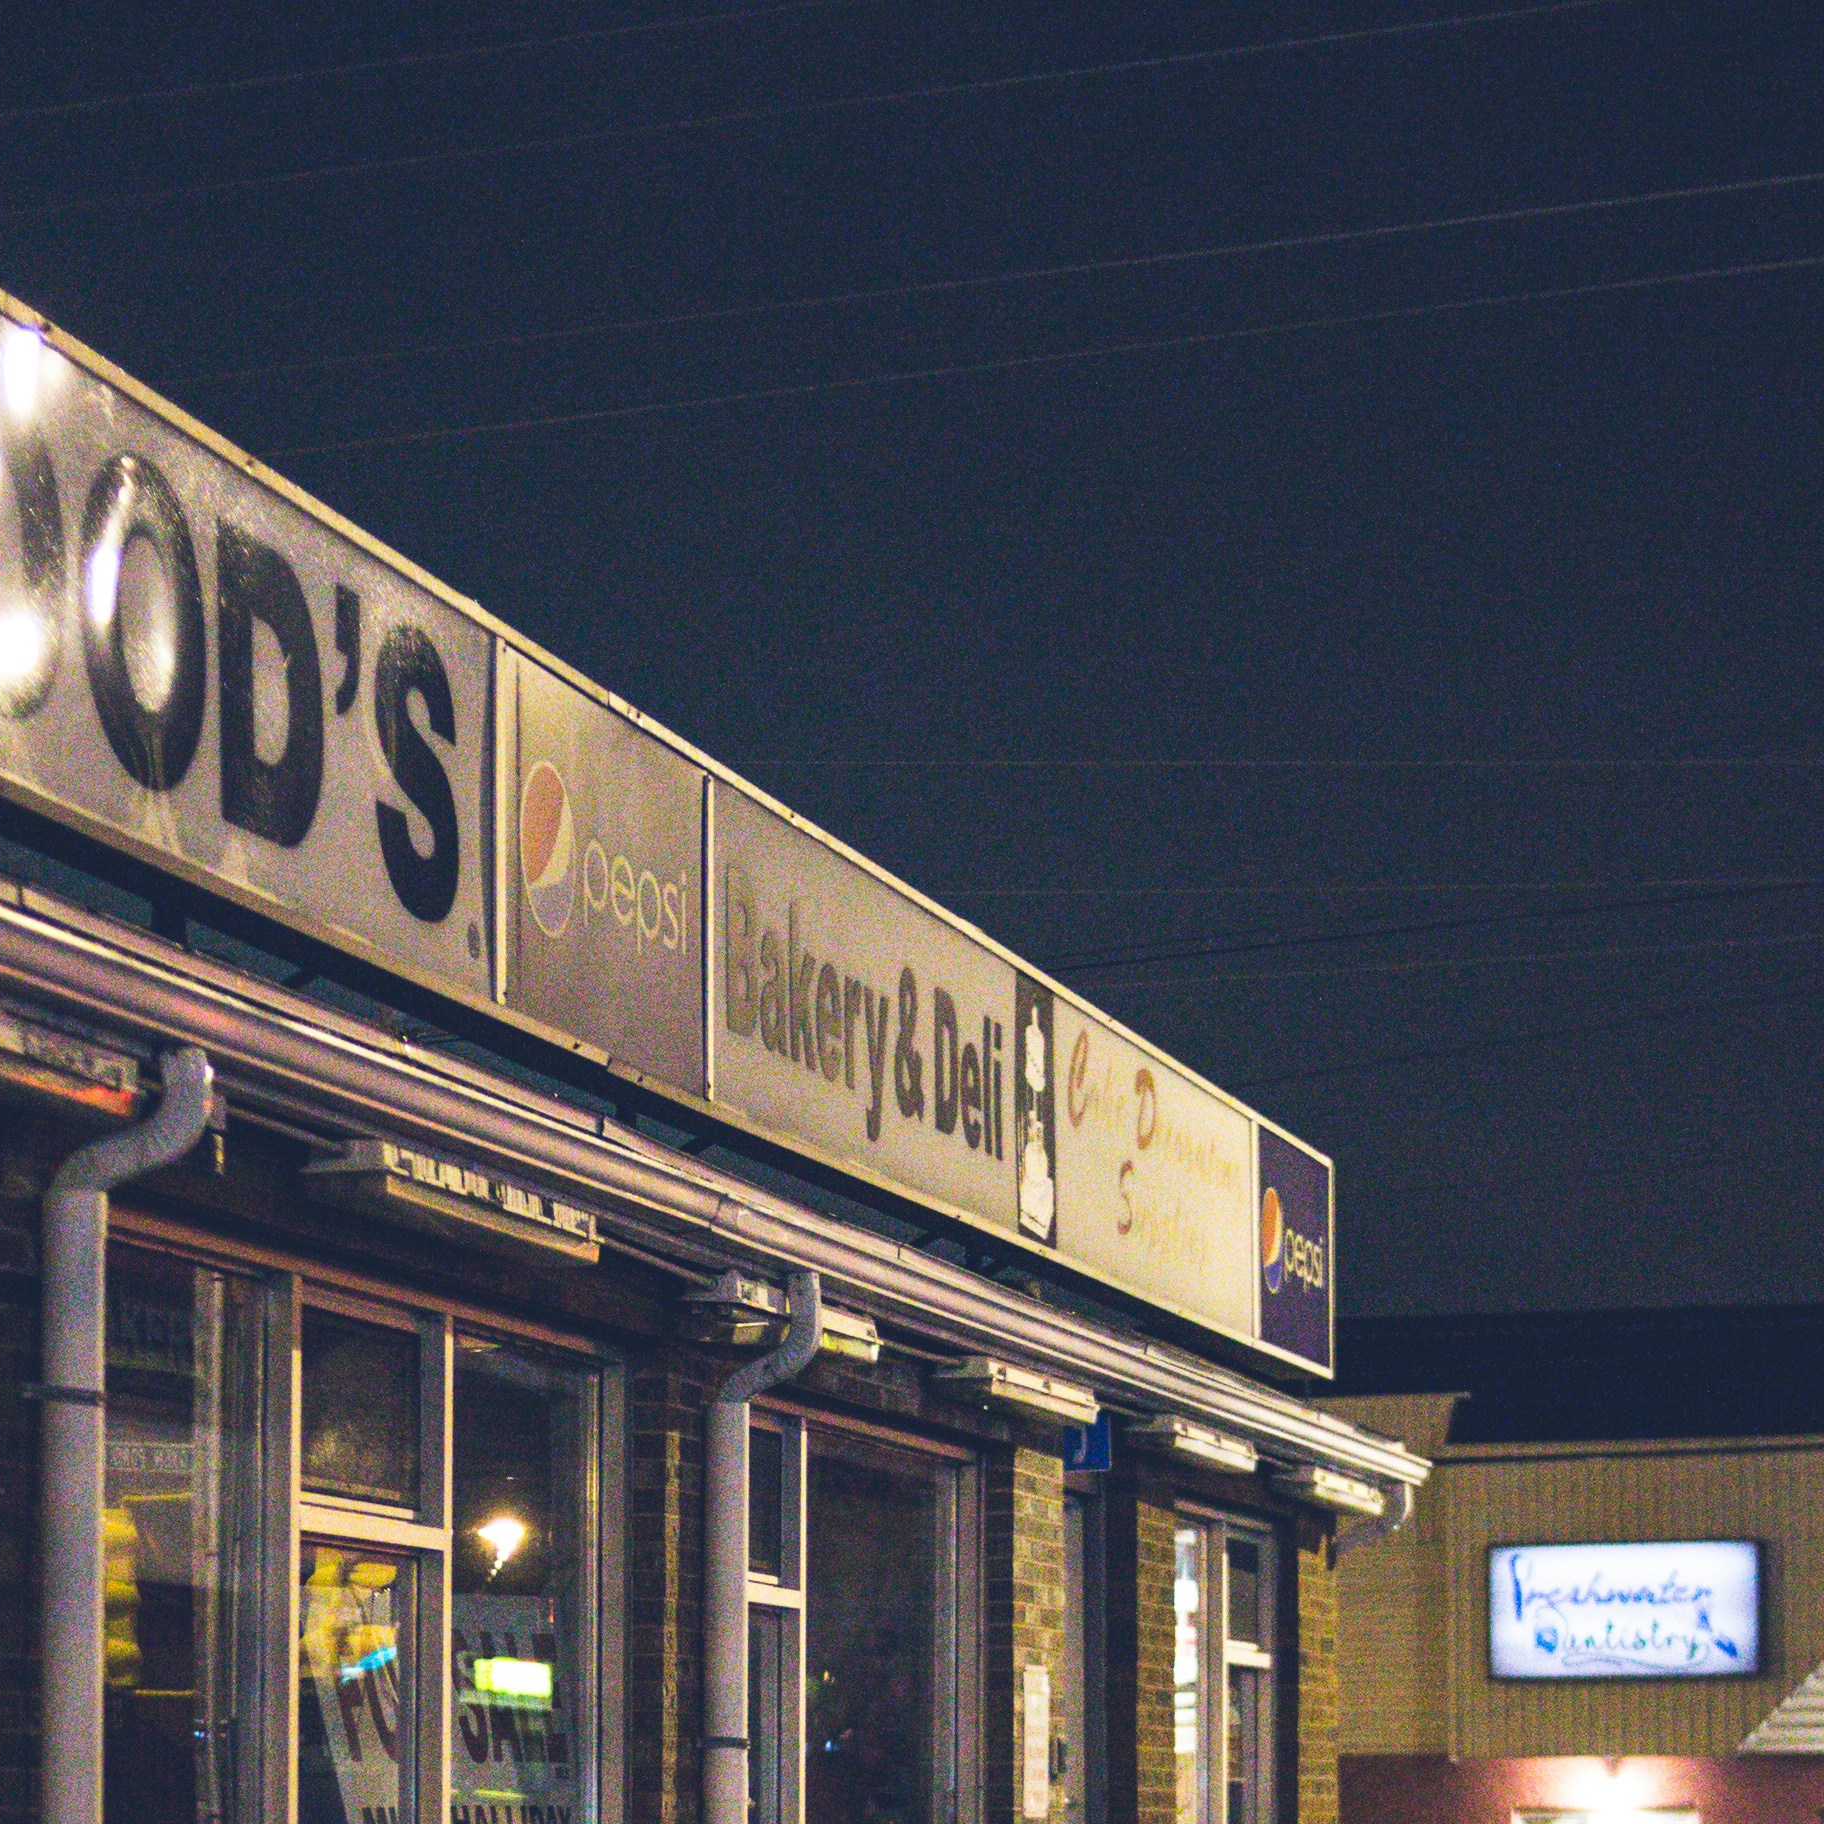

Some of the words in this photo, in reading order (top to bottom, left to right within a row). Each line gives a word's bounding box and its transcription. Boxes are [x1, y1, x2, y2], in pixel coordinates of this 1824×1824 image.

[583, 837, 688, 956] pepsi
[725, 860, 889, 1142] Bakery
[894, 966, 925, 1122] &
[933, 985, 1003, 1162] Deli
[1284, 1226, 1325, 1291] pepsi
[1509, 1553, 1713, 1622] Freshwater
